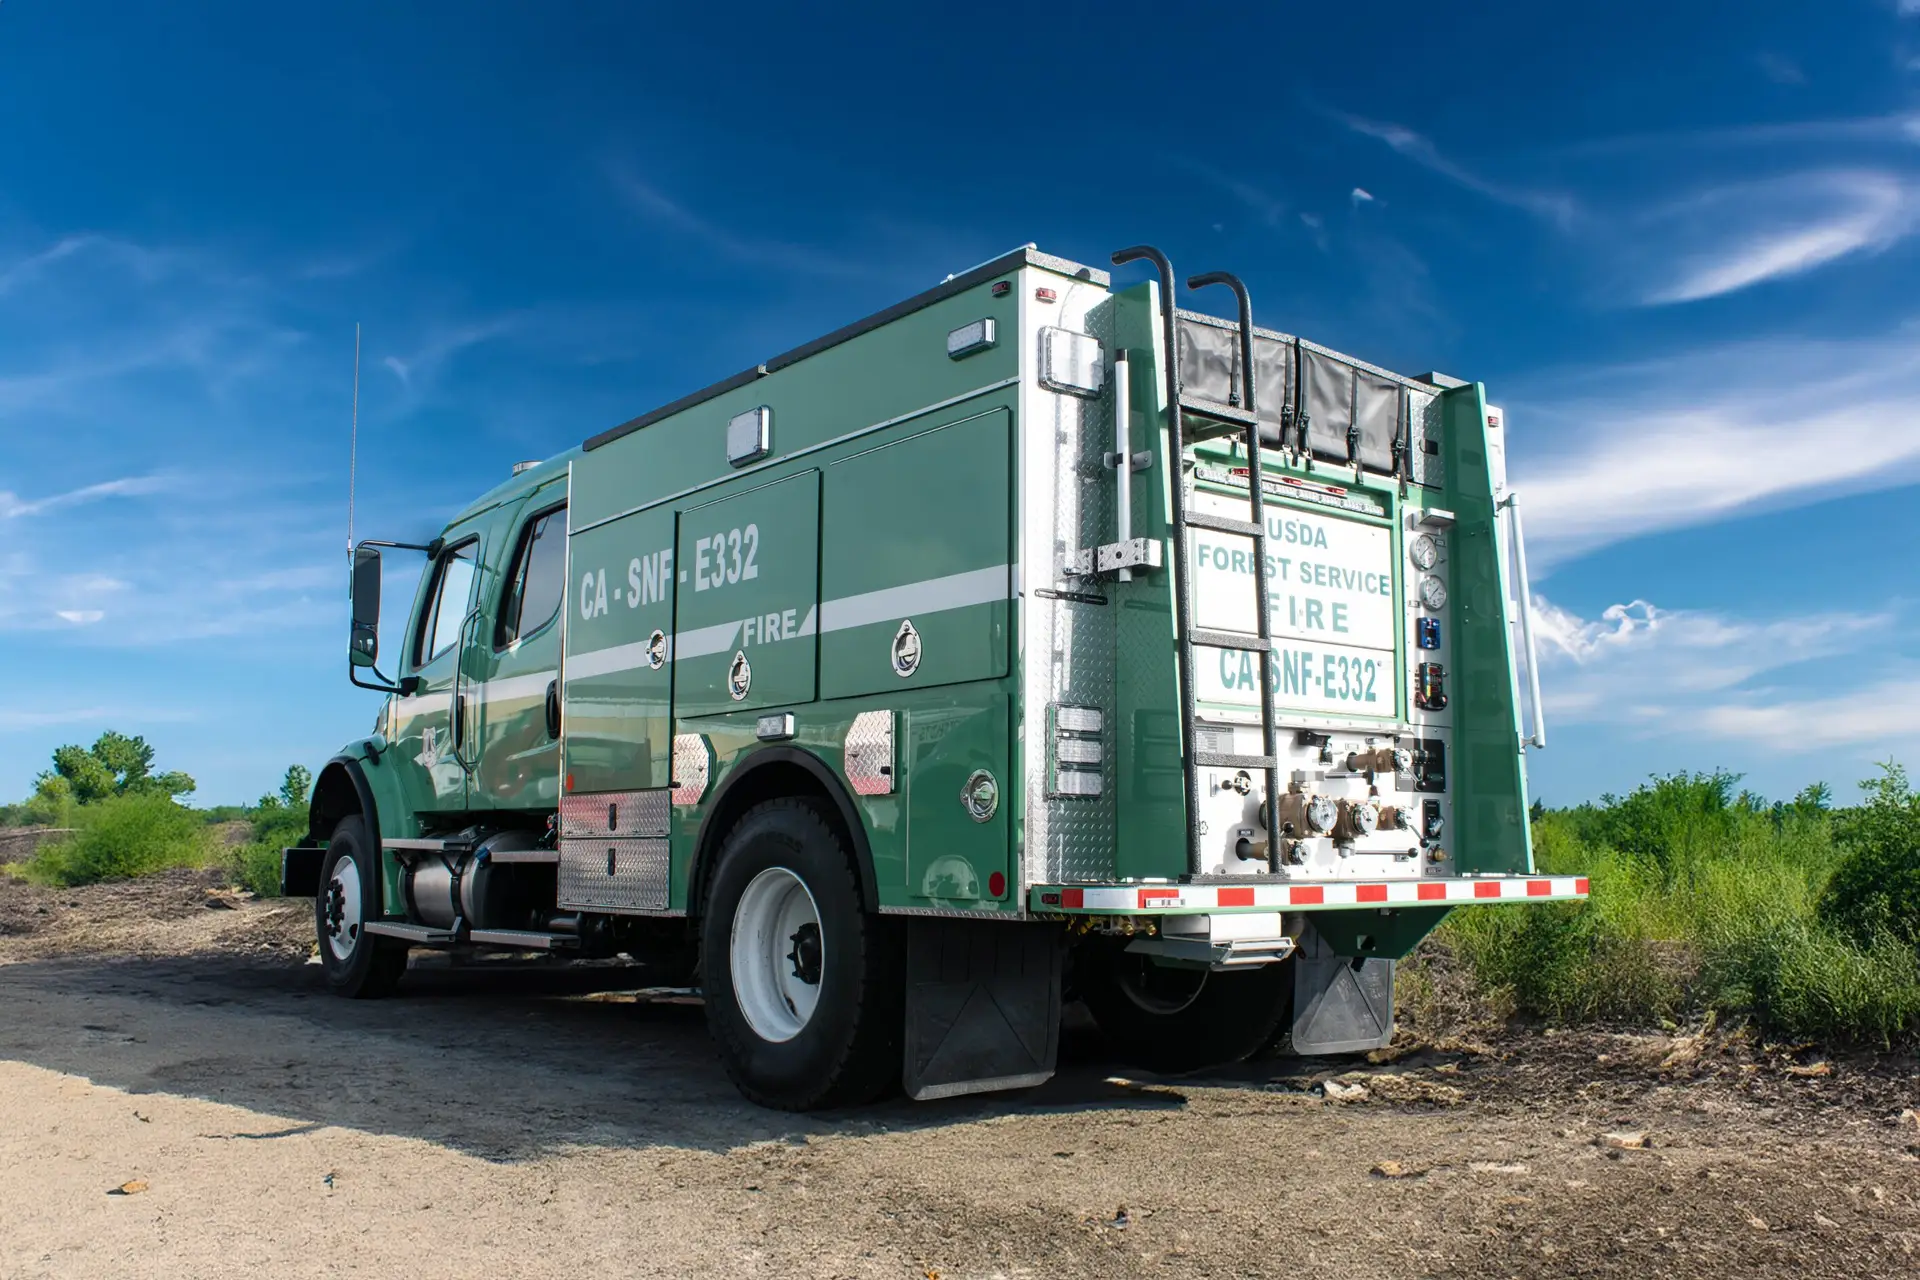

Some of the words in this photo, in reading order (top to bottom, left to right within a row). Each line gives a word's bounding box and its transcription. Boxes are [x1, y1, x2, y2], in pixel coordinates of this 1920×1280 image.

[1268, 518, 1328, 549] USDA
[580, 568, 608, 620] CA
[627, 548, 673, 609] SNF
[695, 524, 759, 592] E332
[1300, 561, 1390, 596] SERVICE
[743, 609, 797, 647] FIRE
